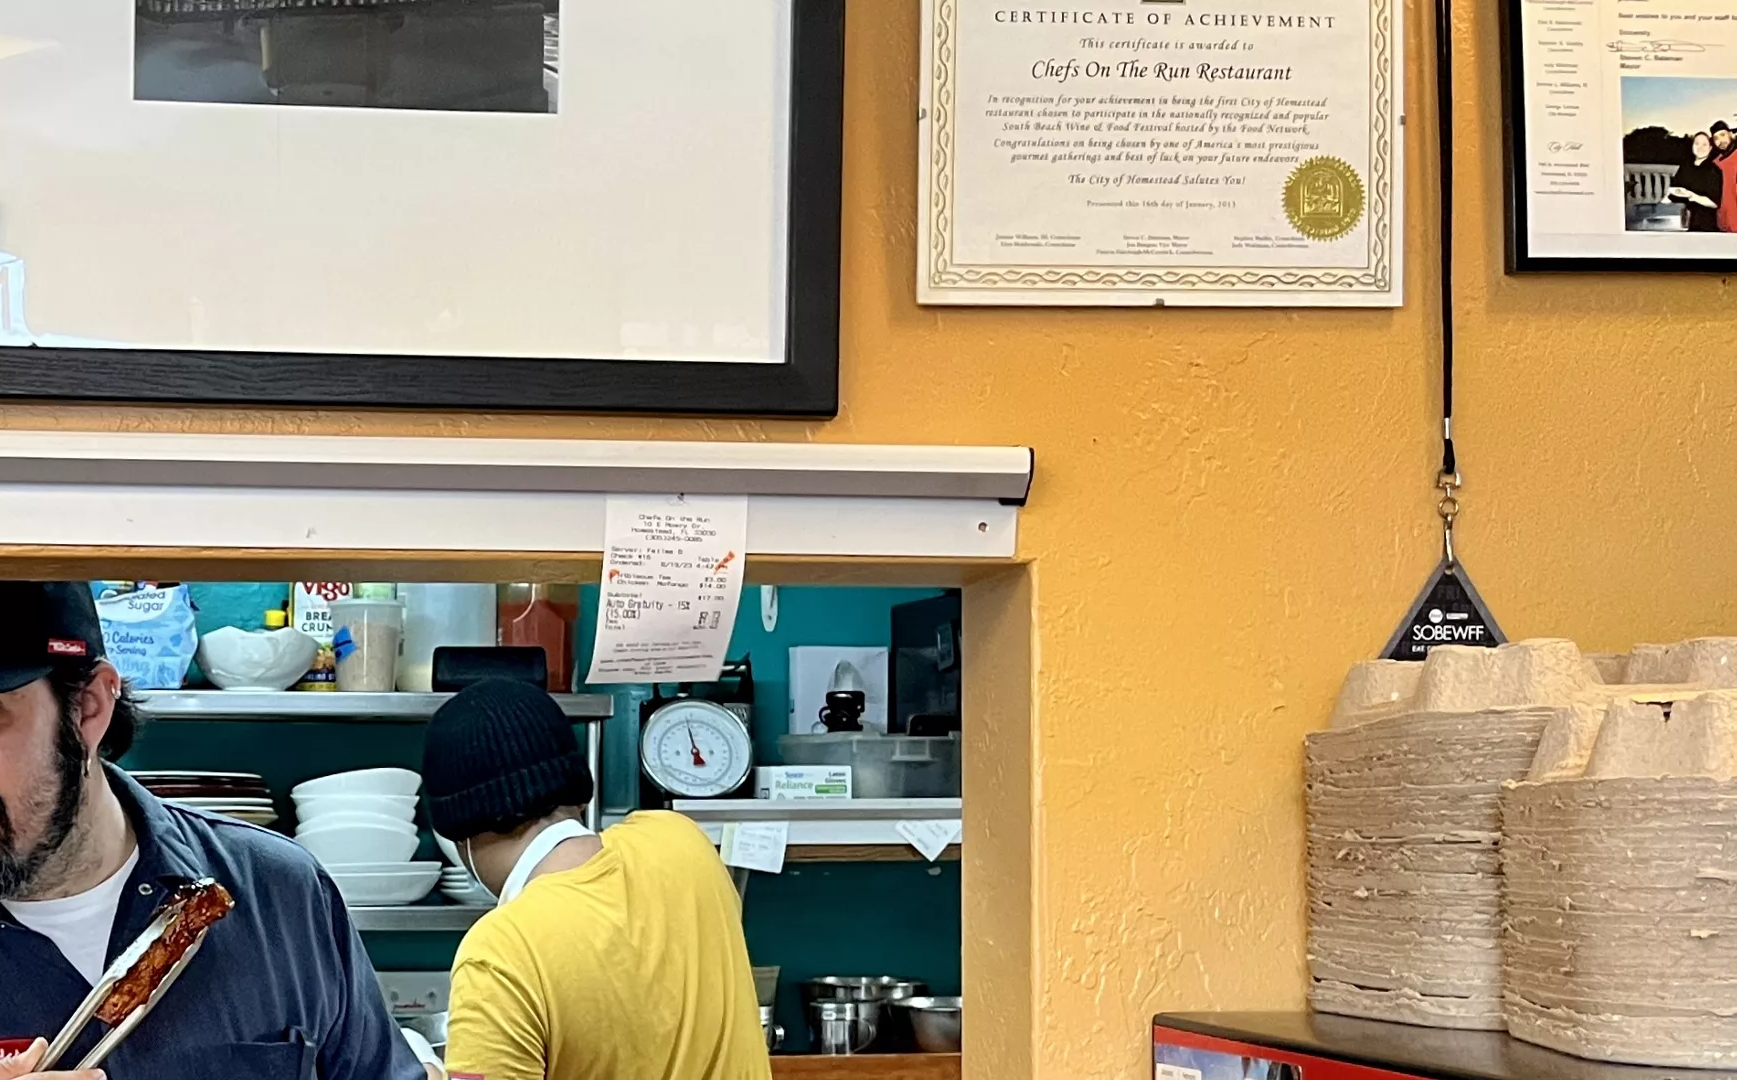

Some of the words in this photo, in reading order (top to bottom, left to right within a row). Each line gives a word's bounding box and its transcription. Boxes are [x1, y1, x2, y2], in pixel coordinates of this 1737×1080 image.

[995, 11, 1135, 24] CERTIFICATE
[1147, 12, 1173, 25] OF
[1185, 14, 1334, 27] ACHIEVEMENT
[1078, 38, 1104, 50] This
[1108, 39, 1169, 50] certificate
[1174, 39, 1184, 51] is
[1188, 40, 1238, 51] awarded
[1242, 40, 1254, 51] to
[1030, 59, 1080, 83] Chefs
[1084, 60, 1111, 83] On
[1114, 60, 1148, 83] The
[1152, 61, 1190, 84] Run
[1195, 62, 1291, 84] Restaurant
[128, 601, 164, 613] Sugar
[1413, 625, 1484, 640] SOBEWFF
